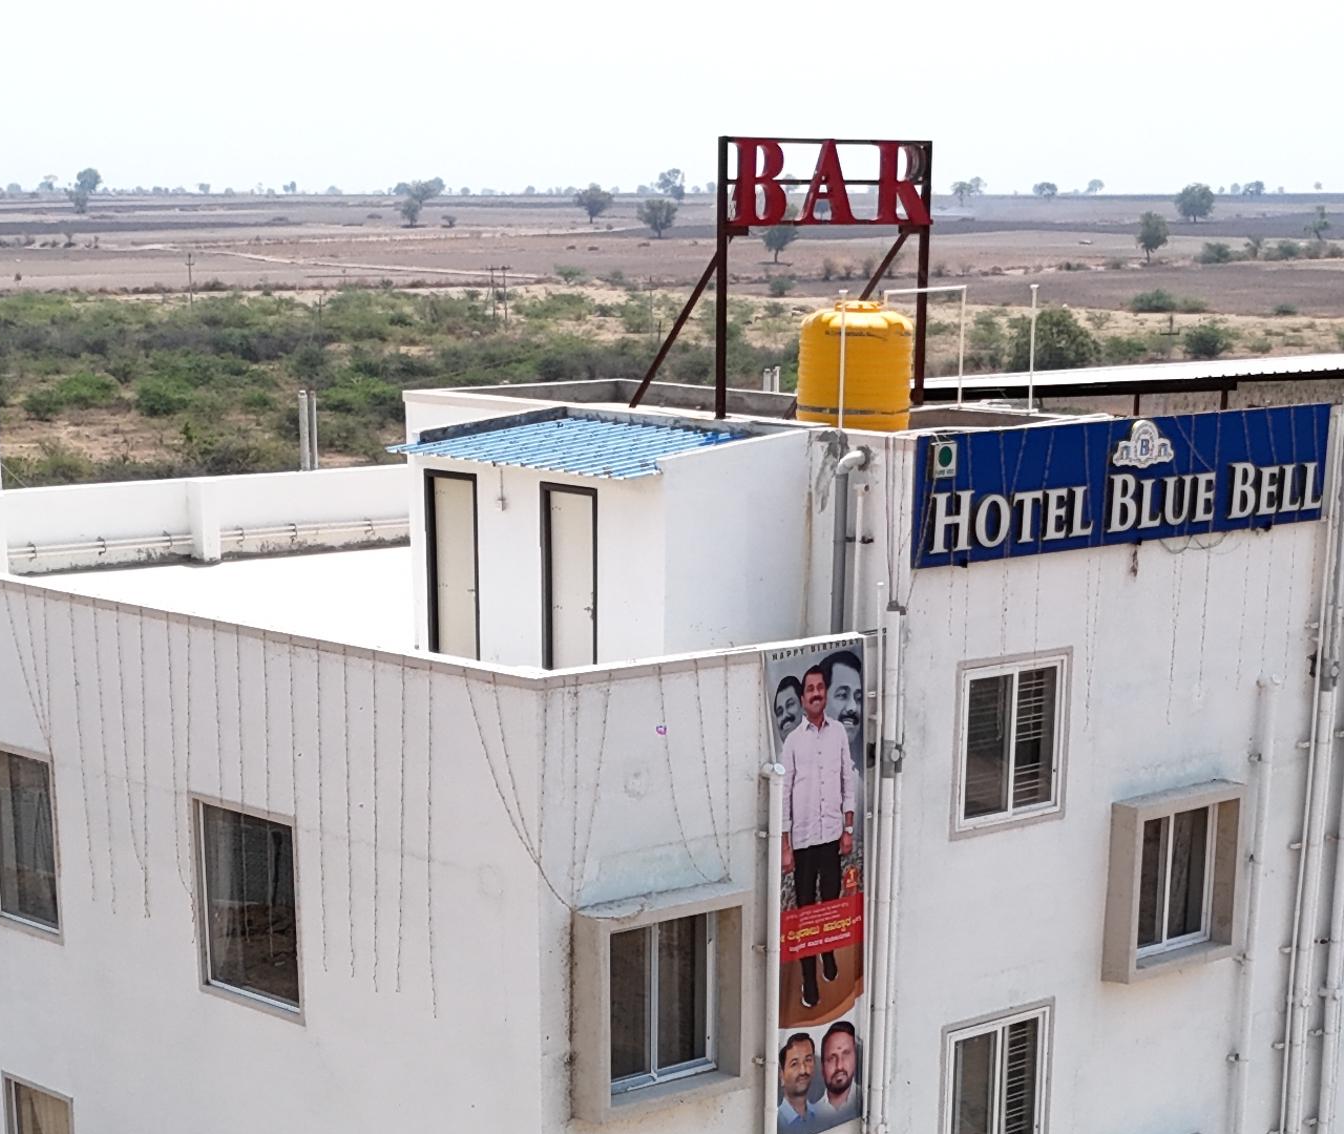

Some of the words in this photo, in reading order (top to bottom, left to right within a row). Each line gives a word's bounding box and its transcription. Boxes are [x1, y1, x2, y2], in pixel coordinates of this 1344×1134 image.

[730, 139, 931, 225] BAR
[929, 485, 1092, 555] HOTEL
[1107, 472, 1216, 533] BLUE
[1227, 461, 1323, 520] BELL
[772, 648, 804, 661] HAPPY
[811, 639, 859, 652] BIRTHDAY
